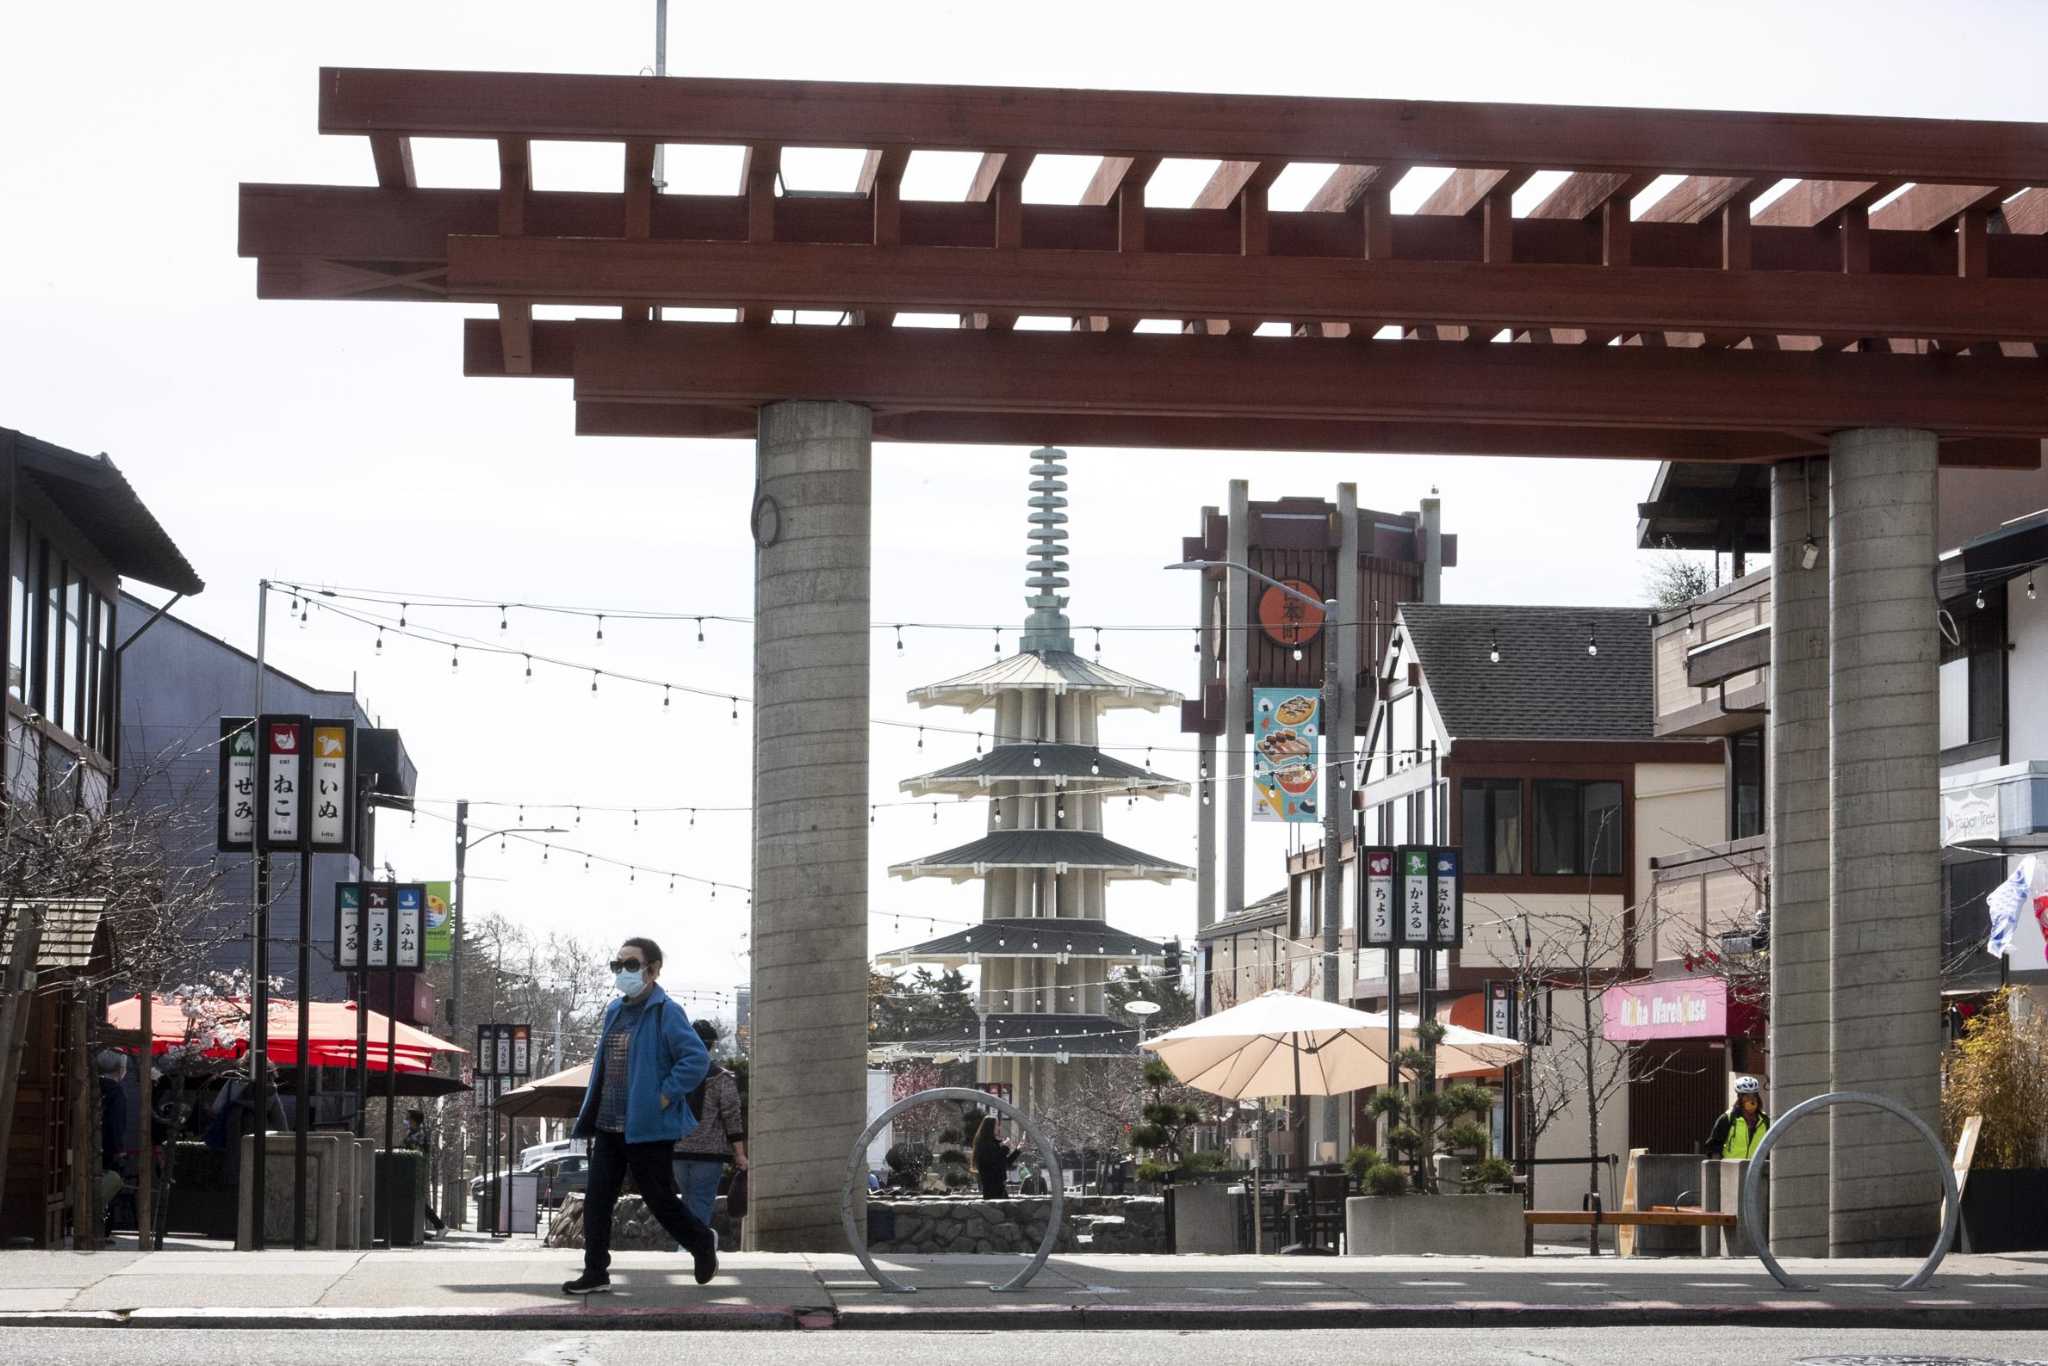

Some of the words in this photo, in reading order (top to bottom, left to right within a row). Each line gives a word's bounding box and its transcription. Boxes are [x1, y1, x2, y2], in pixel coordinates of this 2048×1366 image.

[234, 777, 253, 819] せみ
[273, 774, 294, 817] ねこ
[318, 778, 339, 819] いぬ
[1375, 887, 1386, 928] ちょう
[1410, 887, 1423, 929] かえる
[1438, 887, 1451, 930] さかな
[345, 924, 360, 950] つる
[372, 923, 384, 951] うま
[401, 923, 415, 952] ふね
